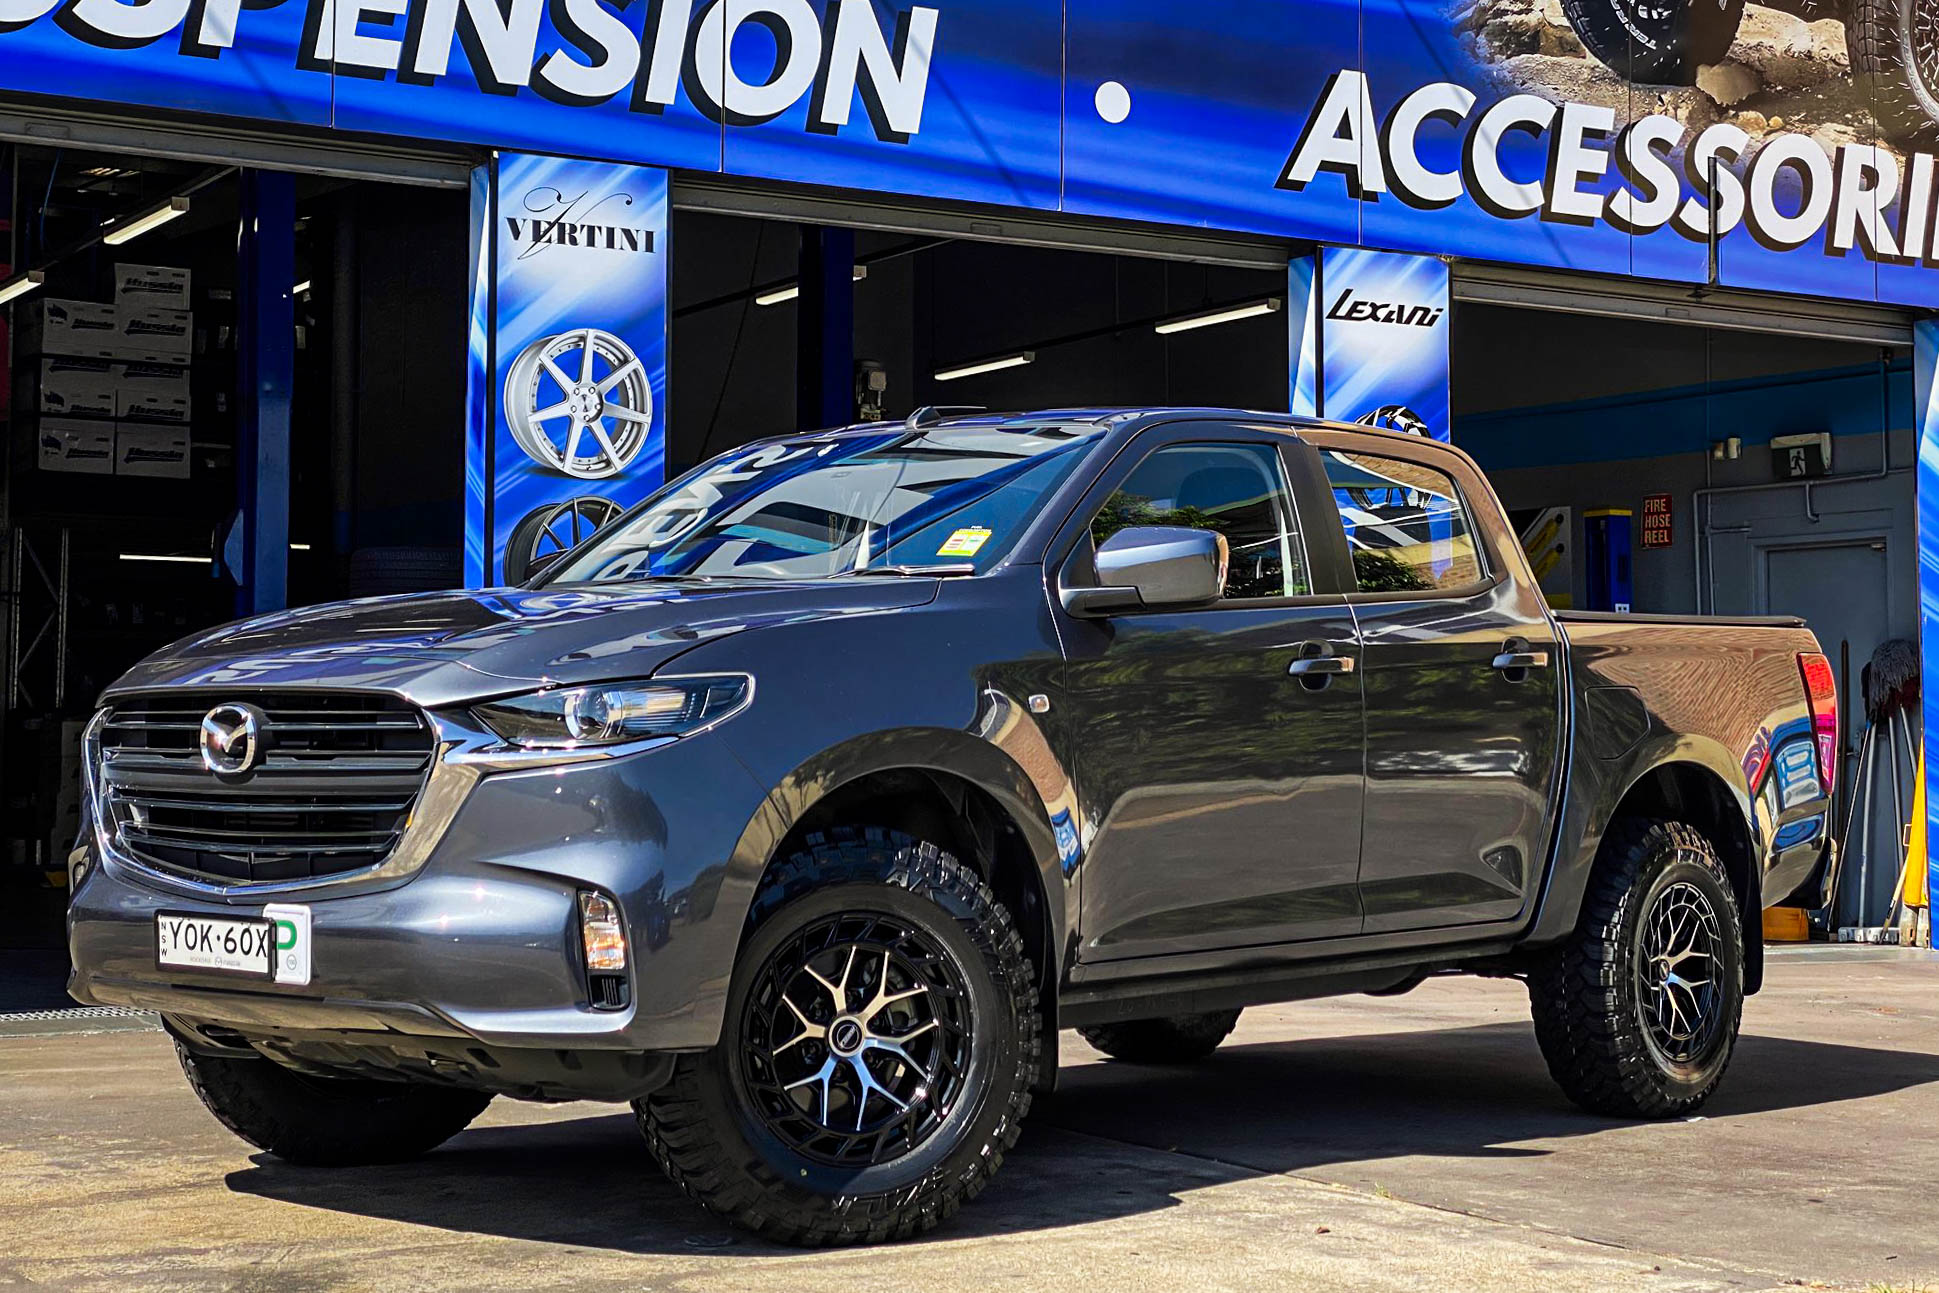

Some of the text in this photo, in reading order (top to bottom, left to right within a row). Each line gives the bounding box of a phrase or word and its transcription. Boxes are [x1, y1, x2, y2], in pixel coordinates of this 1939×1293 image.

[0, 0, 939, 142] ENSION
[1276, 68, 1939, 267] ACCESSORI
[504, 216, 656, 254] VERTINI
[1644, 498, 1667, 512] FIRE
[1645, 513, 1671, 528] HOSE
[1644, 530, 1669, 544] REEL
